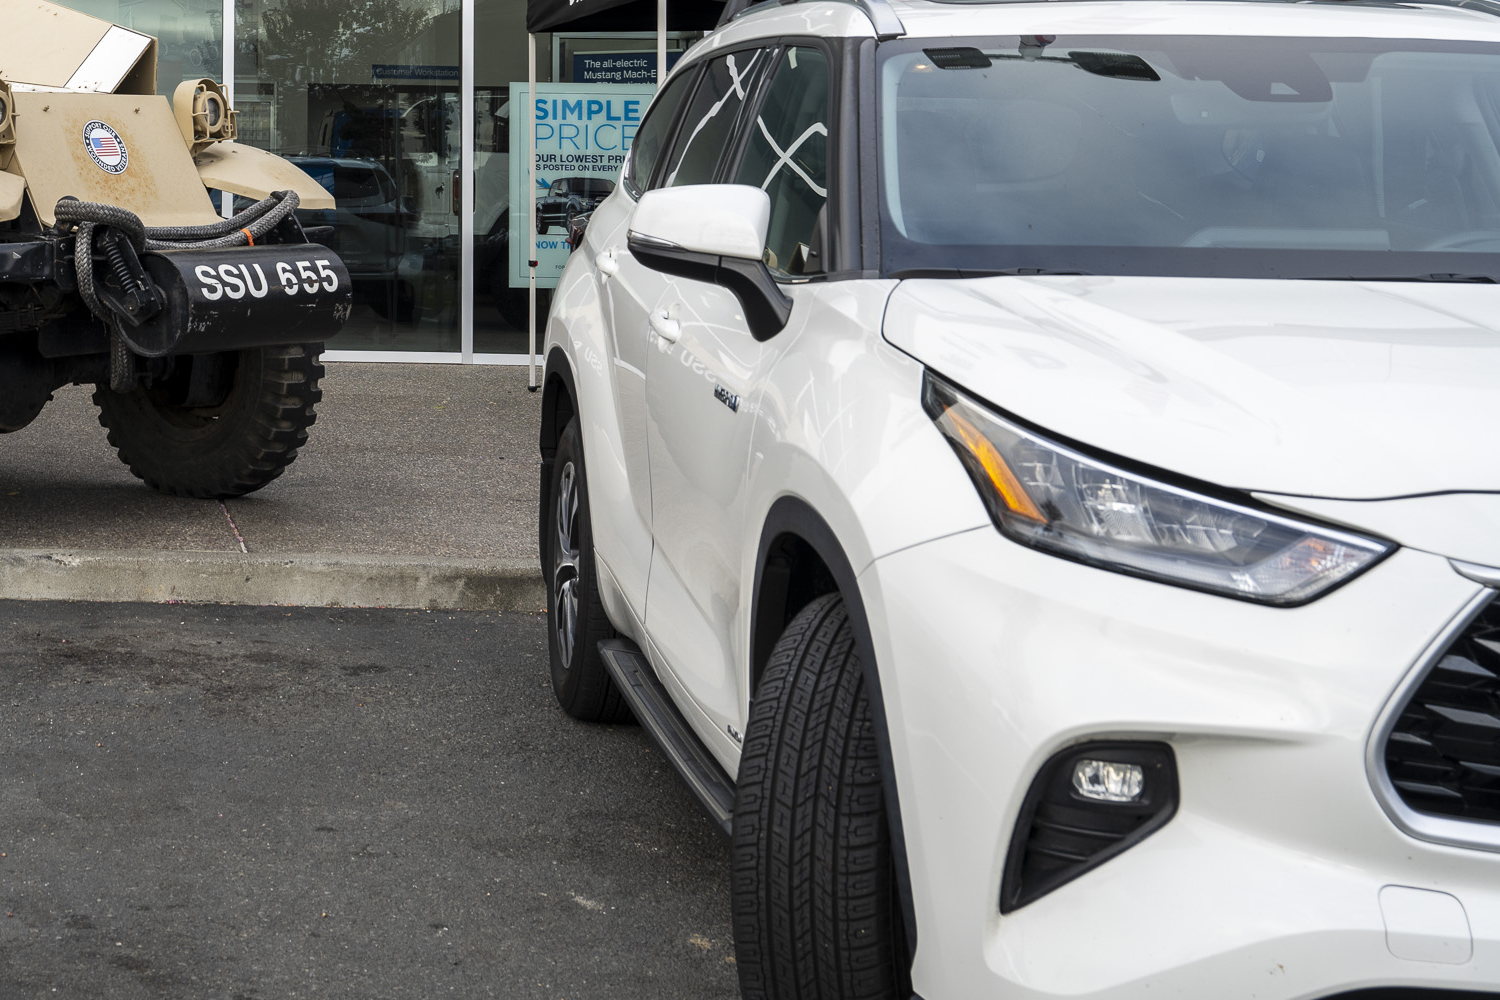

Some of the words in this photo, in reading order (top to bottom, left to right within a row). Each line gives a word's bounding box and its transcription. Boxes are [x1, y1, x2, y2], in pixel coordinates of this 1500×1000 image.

[584, 60, 601, 68] The
[602, 58, 648, 68] all-electric
[414, 68, 459, 77] Workstation
[584, 70, 622, 80] Mustang
[623, 69, 657, 78] Mach-E
[535, 99, 641, 121] SIMPLE
[535, 123, 640, 151] PRICE
[560, 154, 605, 163] LOWEST
[194, 263, 269, 301] SSU
[275, 259, 339, 296] 655
